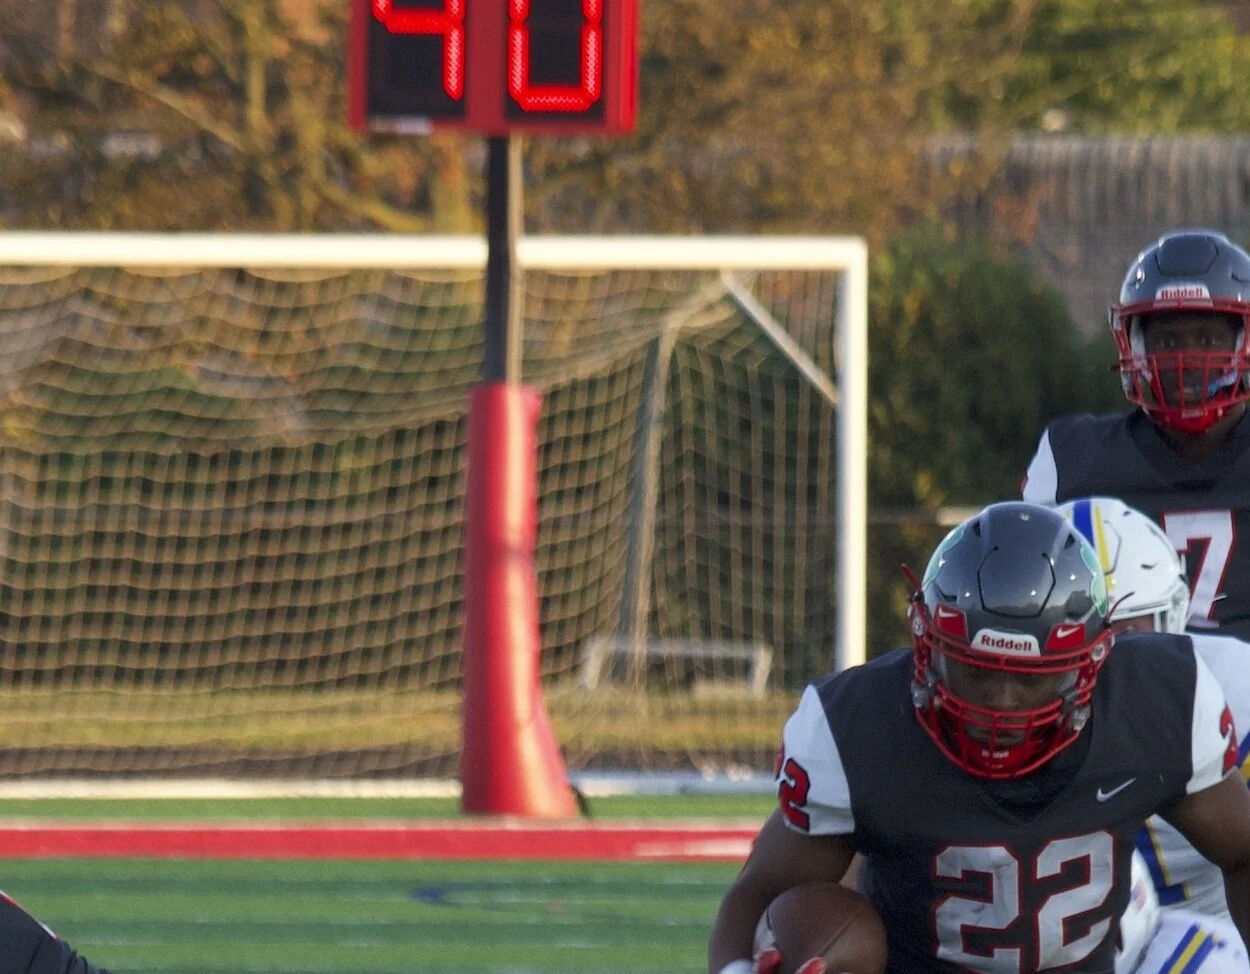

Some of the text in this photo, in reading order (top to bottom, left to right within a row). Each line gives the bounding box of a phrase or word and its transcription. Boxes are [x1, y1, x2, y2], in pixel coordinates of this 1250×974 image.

[366, 0, 603, 112] 40
[1160, 286, 1204, 299] Riddell
[1160, 508, 1237, 628] 7
[981, 634, 1032, 651] Riddell
[774, 744, 811, 833] 2
